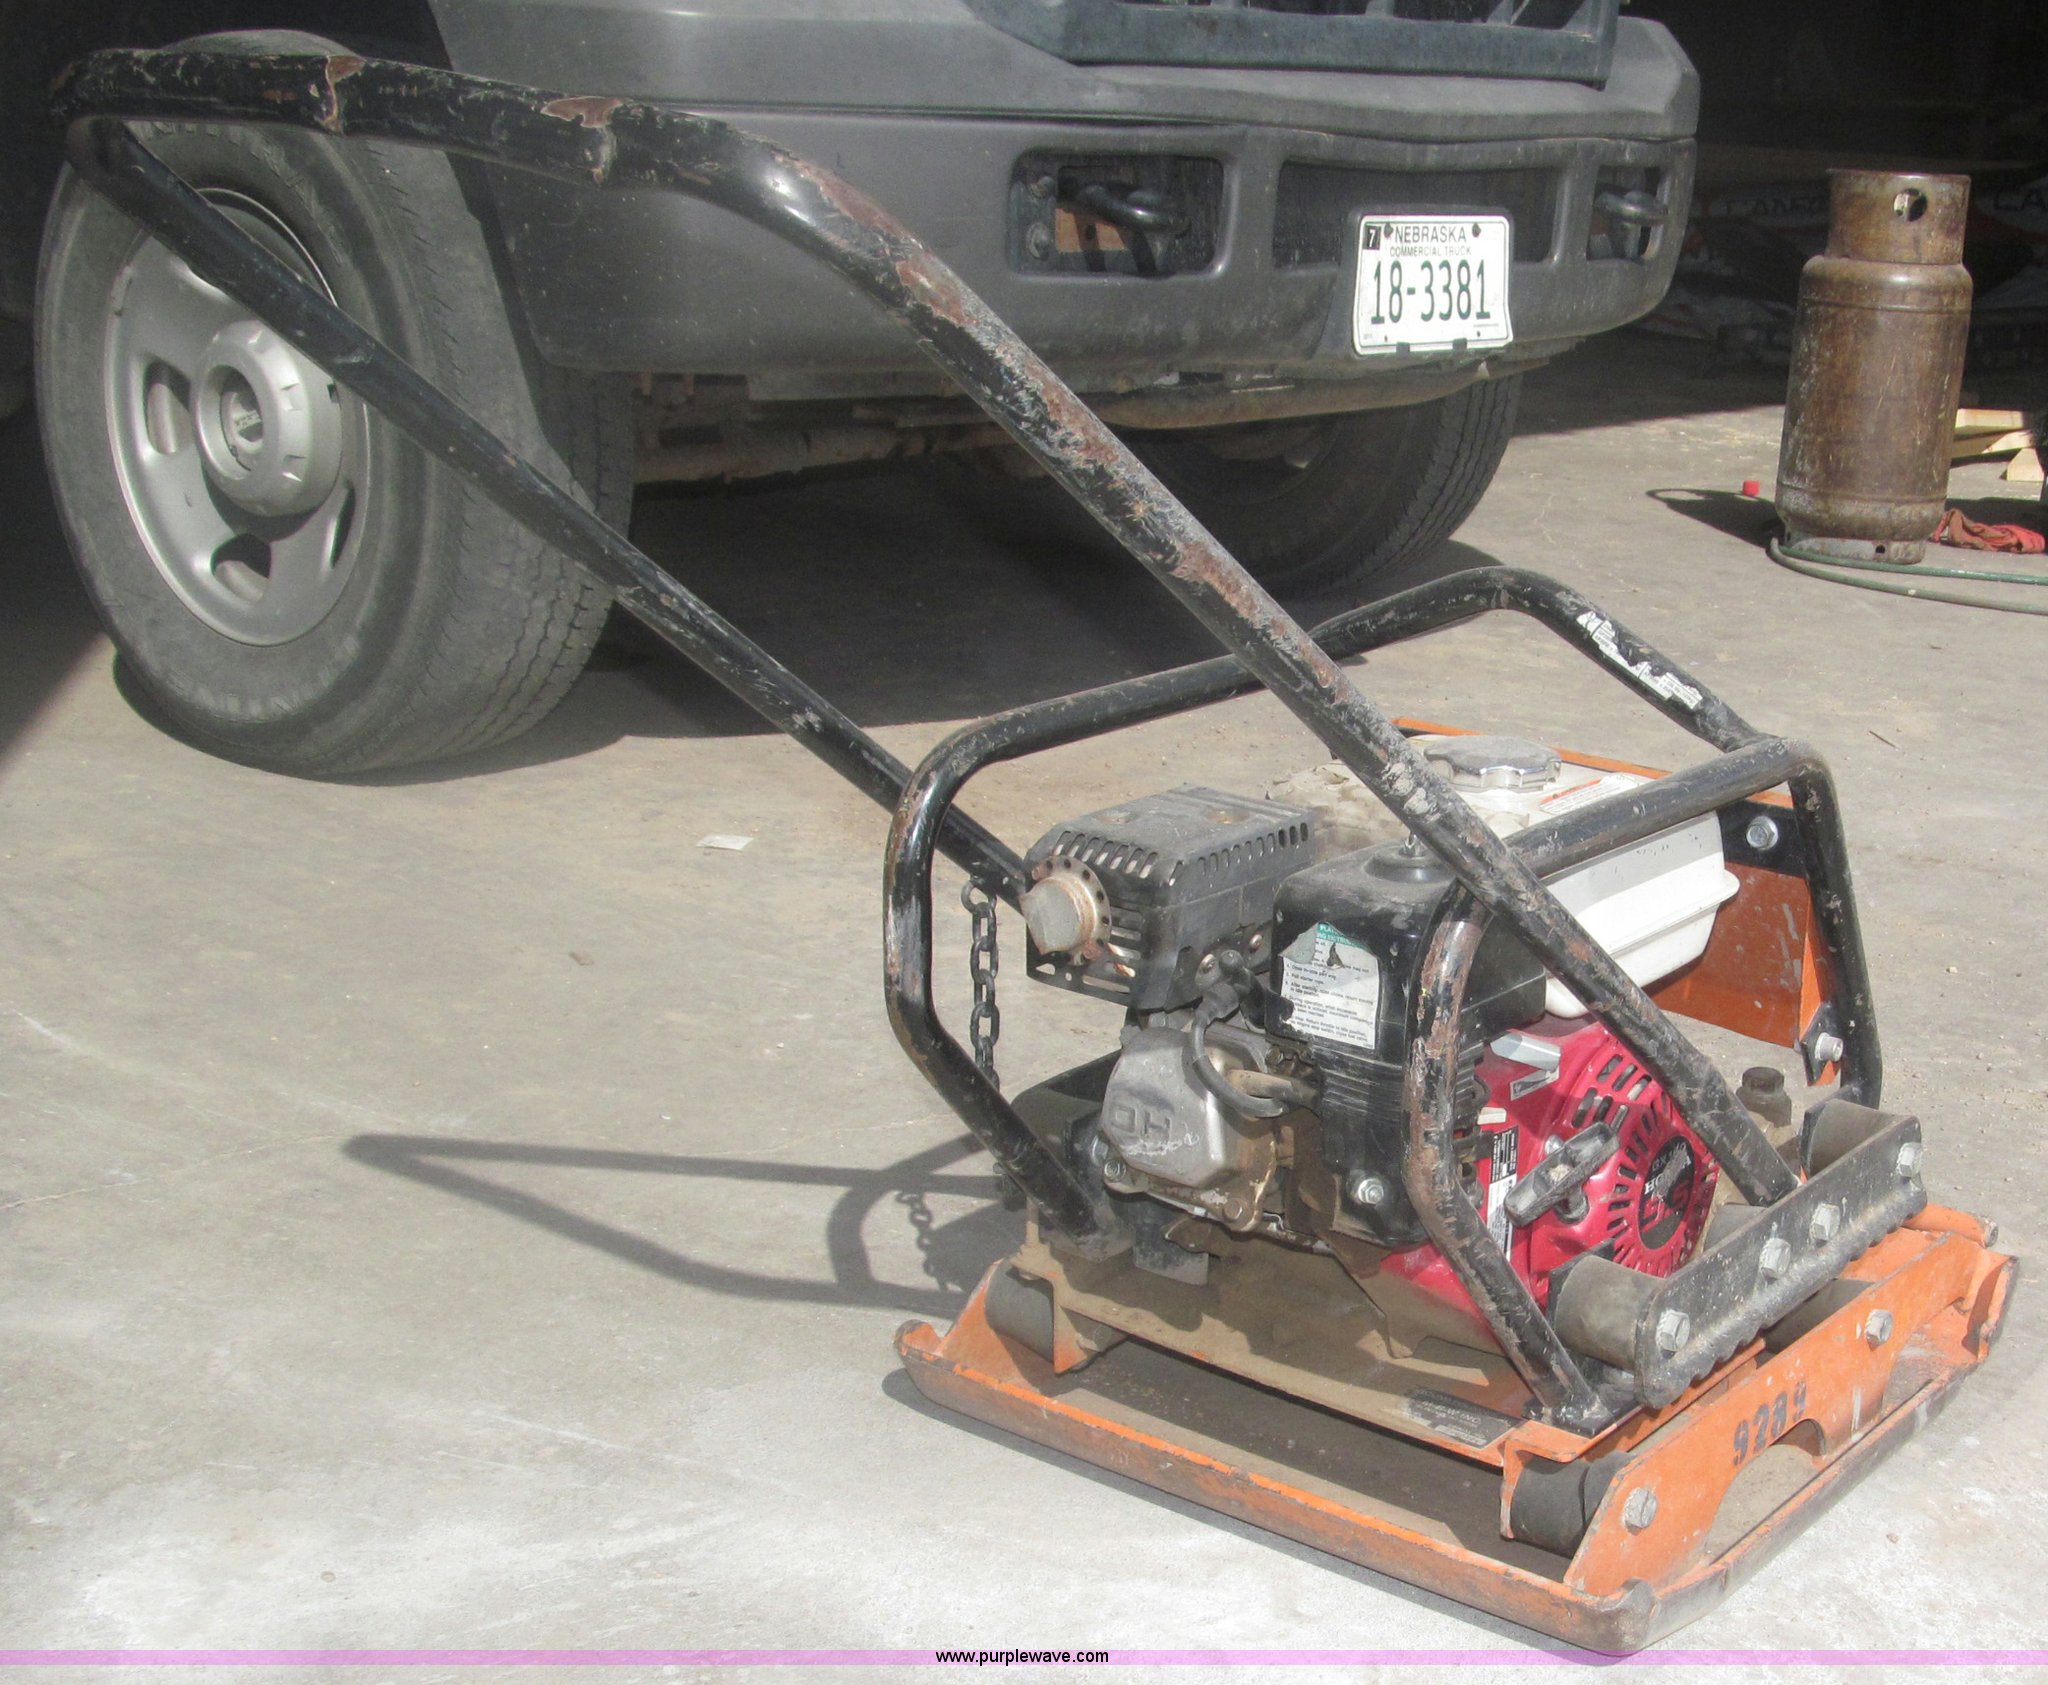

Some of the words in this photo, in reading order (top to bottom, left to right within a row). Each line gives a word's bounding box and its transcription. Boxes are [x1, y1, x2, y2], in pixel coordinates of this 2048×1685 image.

[1369, 229, 1376, 248] 7
[1394, 226, 1467, 243] NEBRASKA
[1389, 246, 1442, 257] COMMERCIAL
[1445, 246, 1472, 256] TRUCK
[1371, 259, 1491, 325] 18-3381
[1644, 1155, 1692, 1195] HOA
